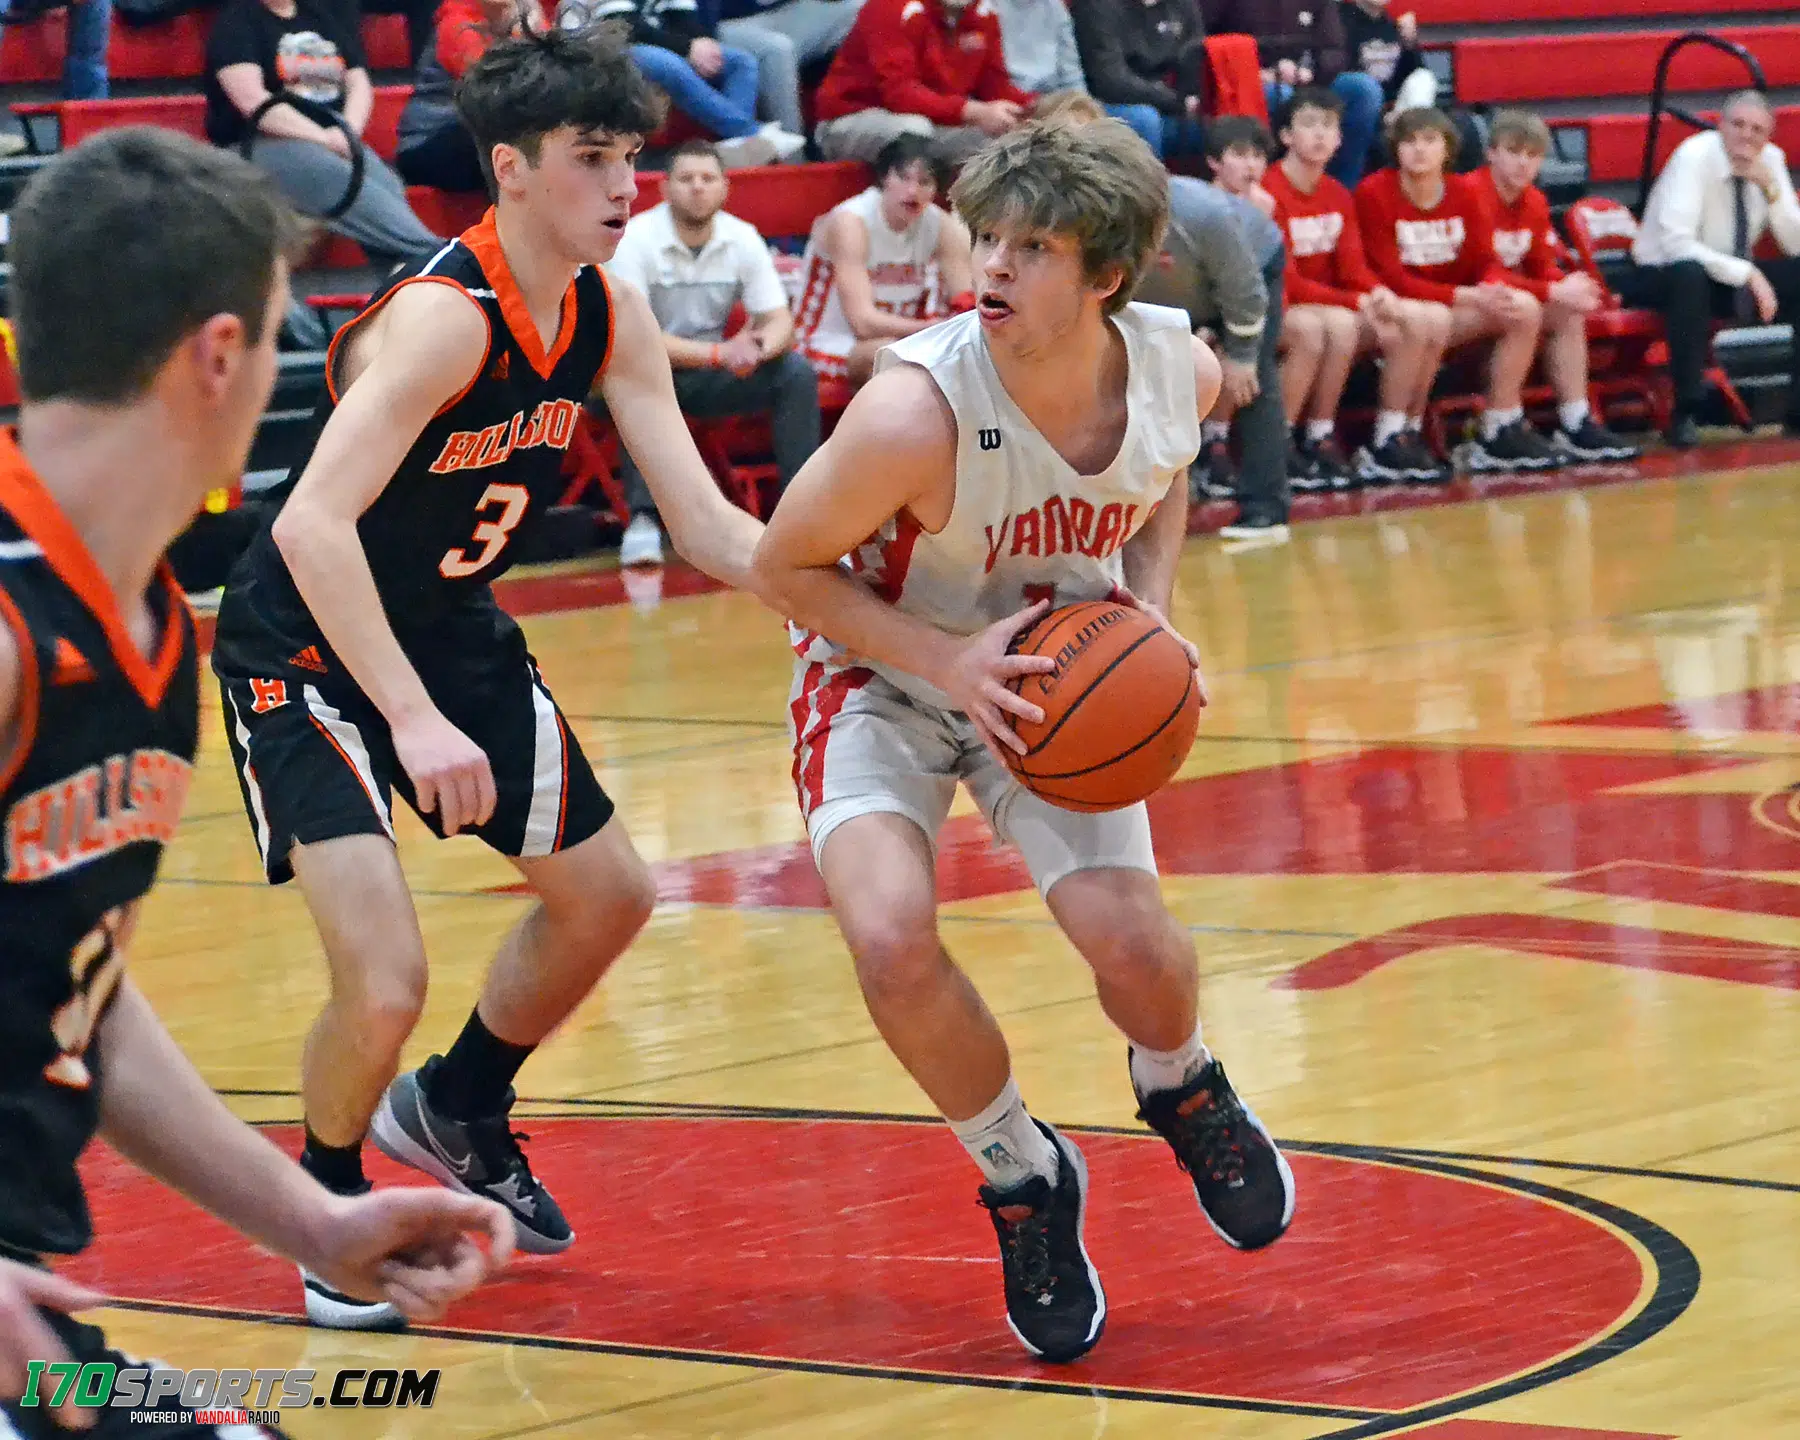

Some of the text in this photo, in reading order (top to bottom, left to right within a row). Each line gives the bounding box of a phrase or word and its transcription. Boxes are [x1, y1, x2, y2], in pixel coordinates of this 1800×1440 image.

[438, 482, 531, 580] 3
[984, 494, 1162, 574] VANDAL
[250, 678, 291, 714] H
